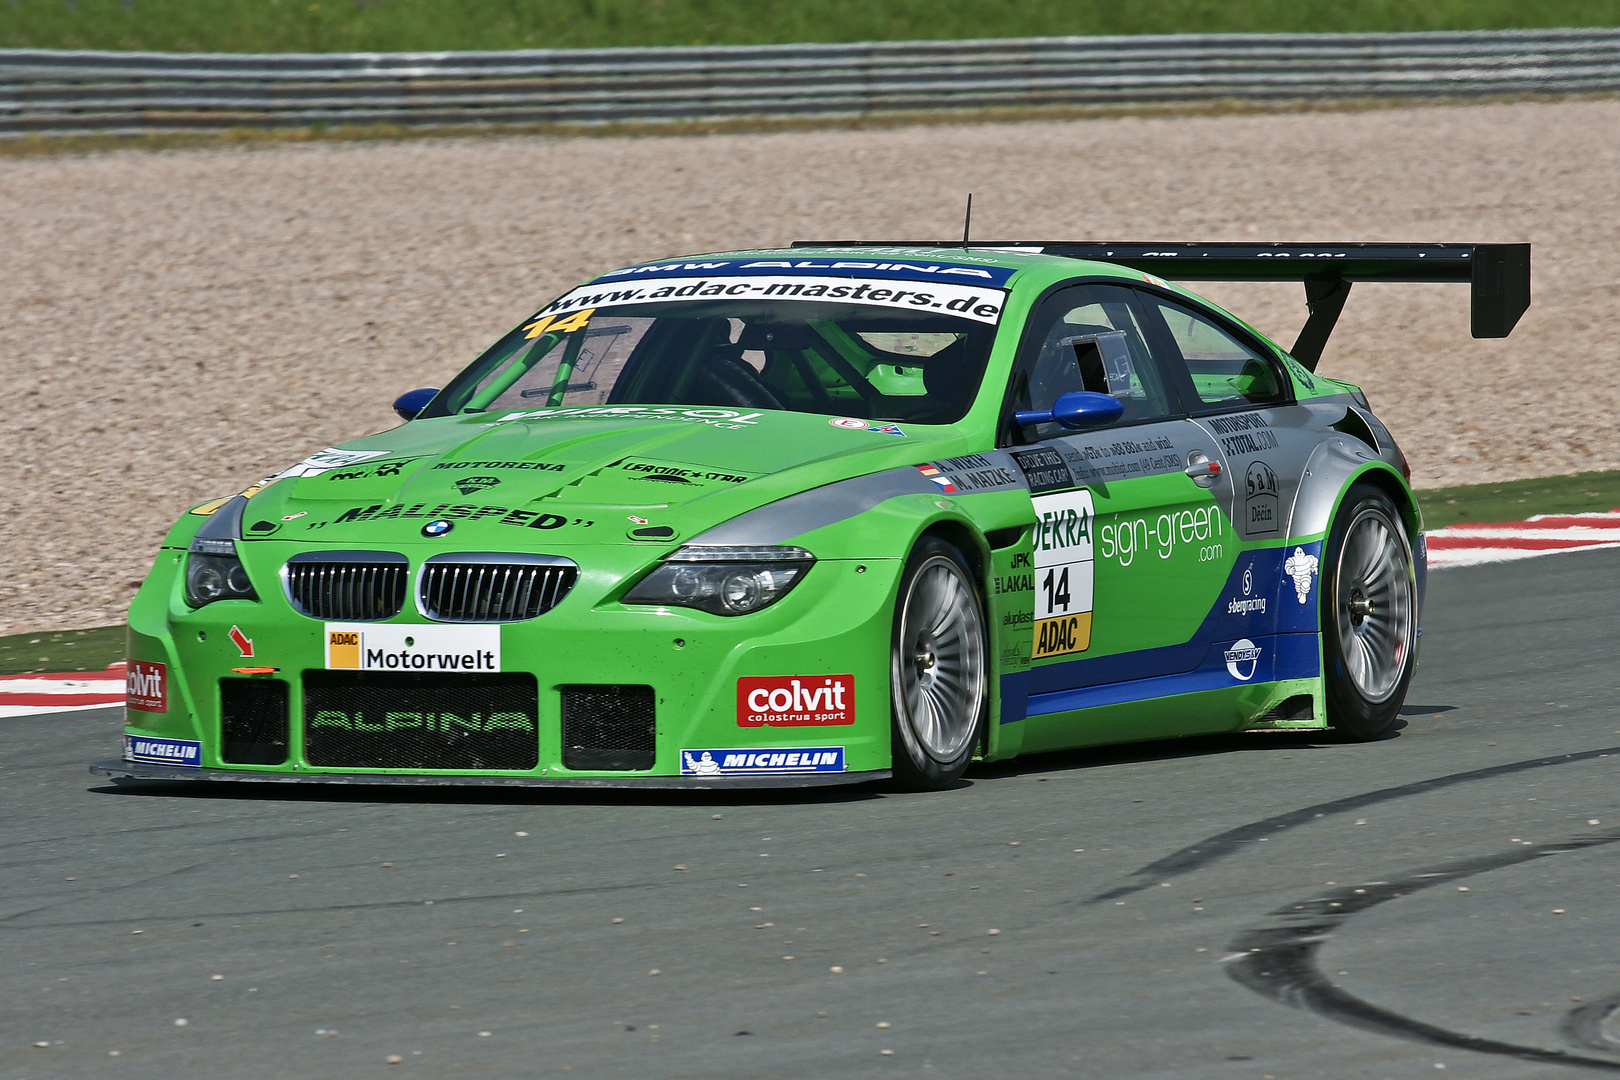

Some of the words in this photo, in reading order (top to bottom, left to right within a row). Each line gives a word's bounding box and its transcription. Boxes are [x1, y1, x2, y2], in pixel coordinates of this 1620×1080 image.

[602, 261, 730, 278] BMW
[739, 260, 993, 279] ALPINA
[548, 280, 1000, 318] www.adac-masters.de
[521, 308, 596, 340] 14
[496, 407, 764, 424] WIRSOL
[1207, 412, 1269, 435] MOTORSPORT
[1141, 438, 1157, 452] and
[431, 461, 566, 472] MOTORENA
[950, 453, 992, 470] WIRTH
[1017, 453, 1043, 470] DRIVE
[1042, 451, 1062, 466] THIS
[951, 475, 972, 491] M.
[965, 467, 1016, 489] MATZKE
[1028, 471, 1055, 487] RACING
[1101, 505, 1222, 567] sign-green
[1011, 552, 1031, 569] JPK
[1198, 543, 1223, 562] .com
[1001, 574, 1034, 594] LAKAL
[1043, 566, 1071, 614] 14
[1003, 610, 1034, 628] aluplast
[330, 633, 358, 646] ADAC
[1037, 617, 1078, 655] ADAC
[366, 649, 495, 670] Motorwelt
[127, 664, 162, 698] olvit
[747, 679, 846, 712] colvit
[311, 710, 535, 732] ALPINA
[748, 713, 810, 722] colostrum
[814, 712, 846, 722] sport
[134, 741, 198, 759] MICHELIN
[722, 752, 838, 767] MICHELIN
